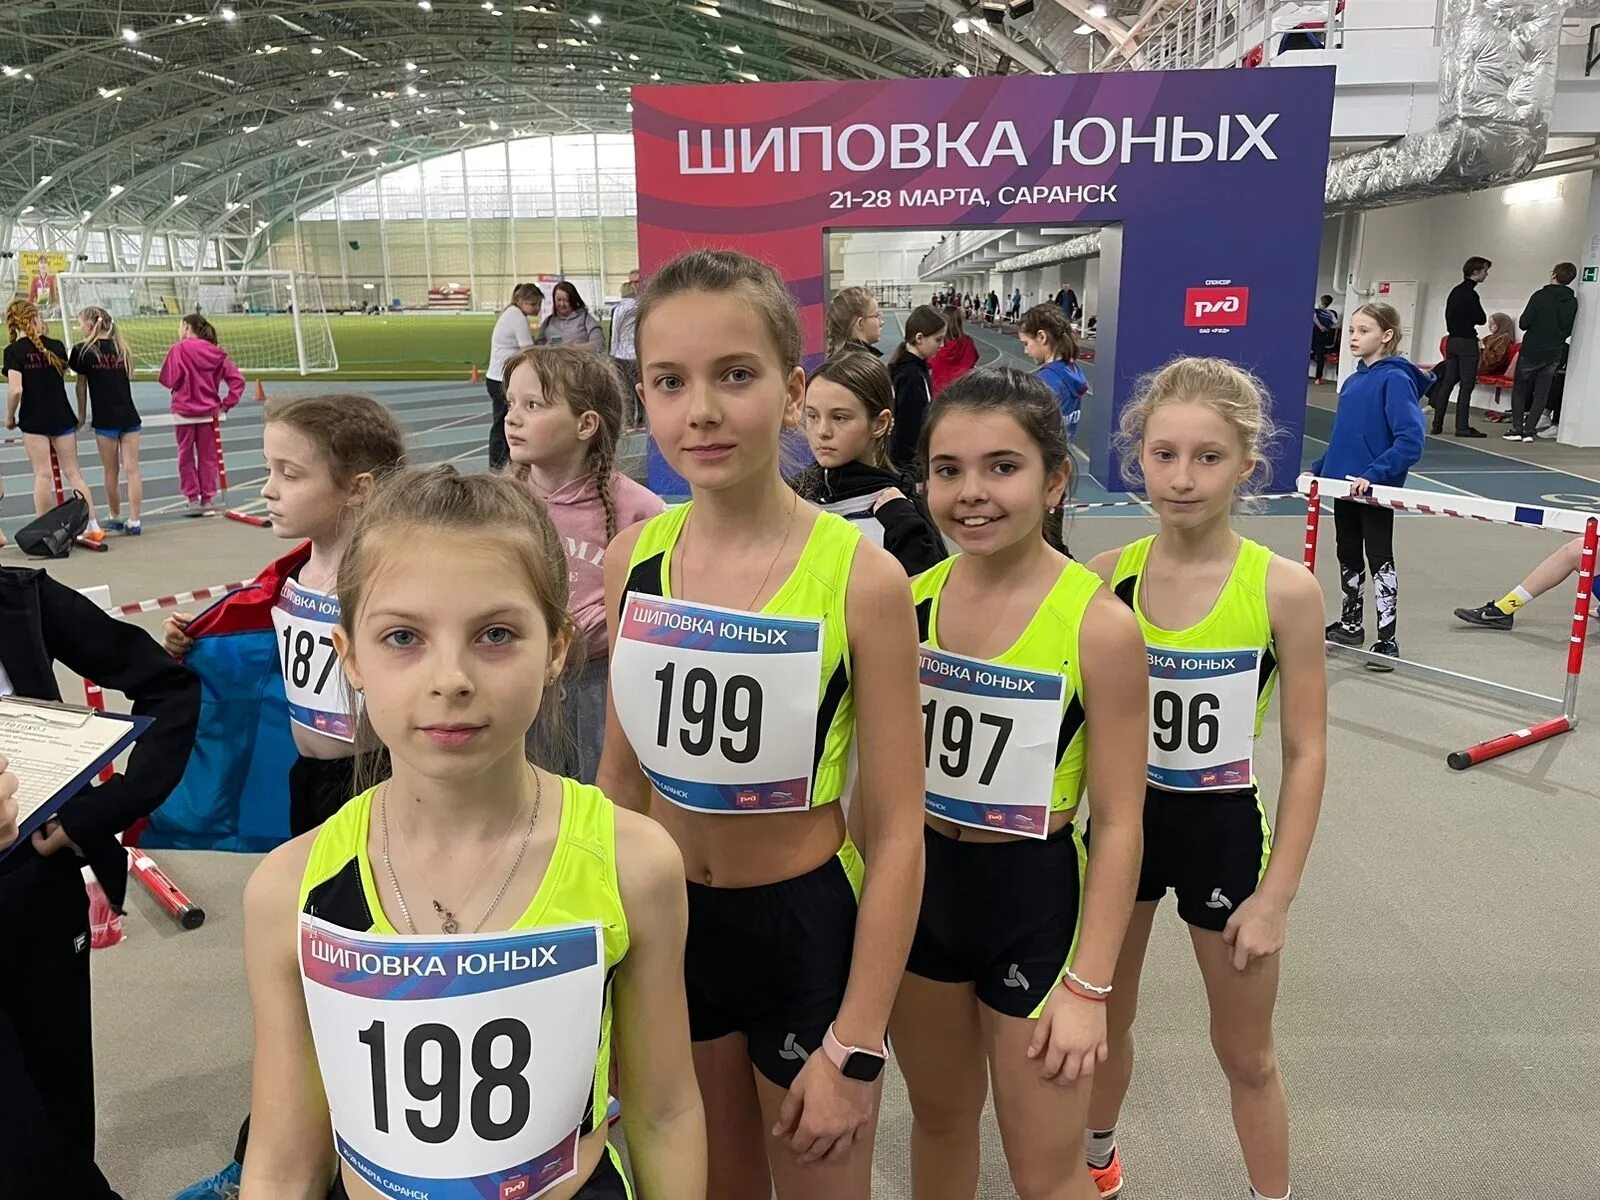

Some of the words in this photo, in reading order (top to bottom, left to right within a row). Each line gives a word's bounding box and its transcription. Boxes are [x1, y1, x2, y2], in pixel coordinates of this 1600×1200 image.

[678, 119, 1028, 176] ШИПОВКА
[1052, 112, 1280, 166] ЮНЫХ
[829, 190, 892, 210] 21-28
[899, 188, 992, 208] МАРТА,
[998, 184, 1118, 206] САРАНСК
[632, 606, 714, 636] ШИПОВКА
[719, 622, 788, 646] ЮНЫХ
[283, 625, 339, 695] 187
[975, 671, 1036, 693] ЮНЫХ
[1181, 657, 1236, 671] ЮНЫХ
[655, 661, 764, 765] 199
[1153, 690, 1220, 754] 96
[921, 698, 1014, 786] 197
[311, 939, 447, 977] ШИПОВКА
[456, 944, 558, 976] ЮНЫХ
[358, 1017, 532, 1144] 198
[383, 1179, 429, 1200] САРАНСК
